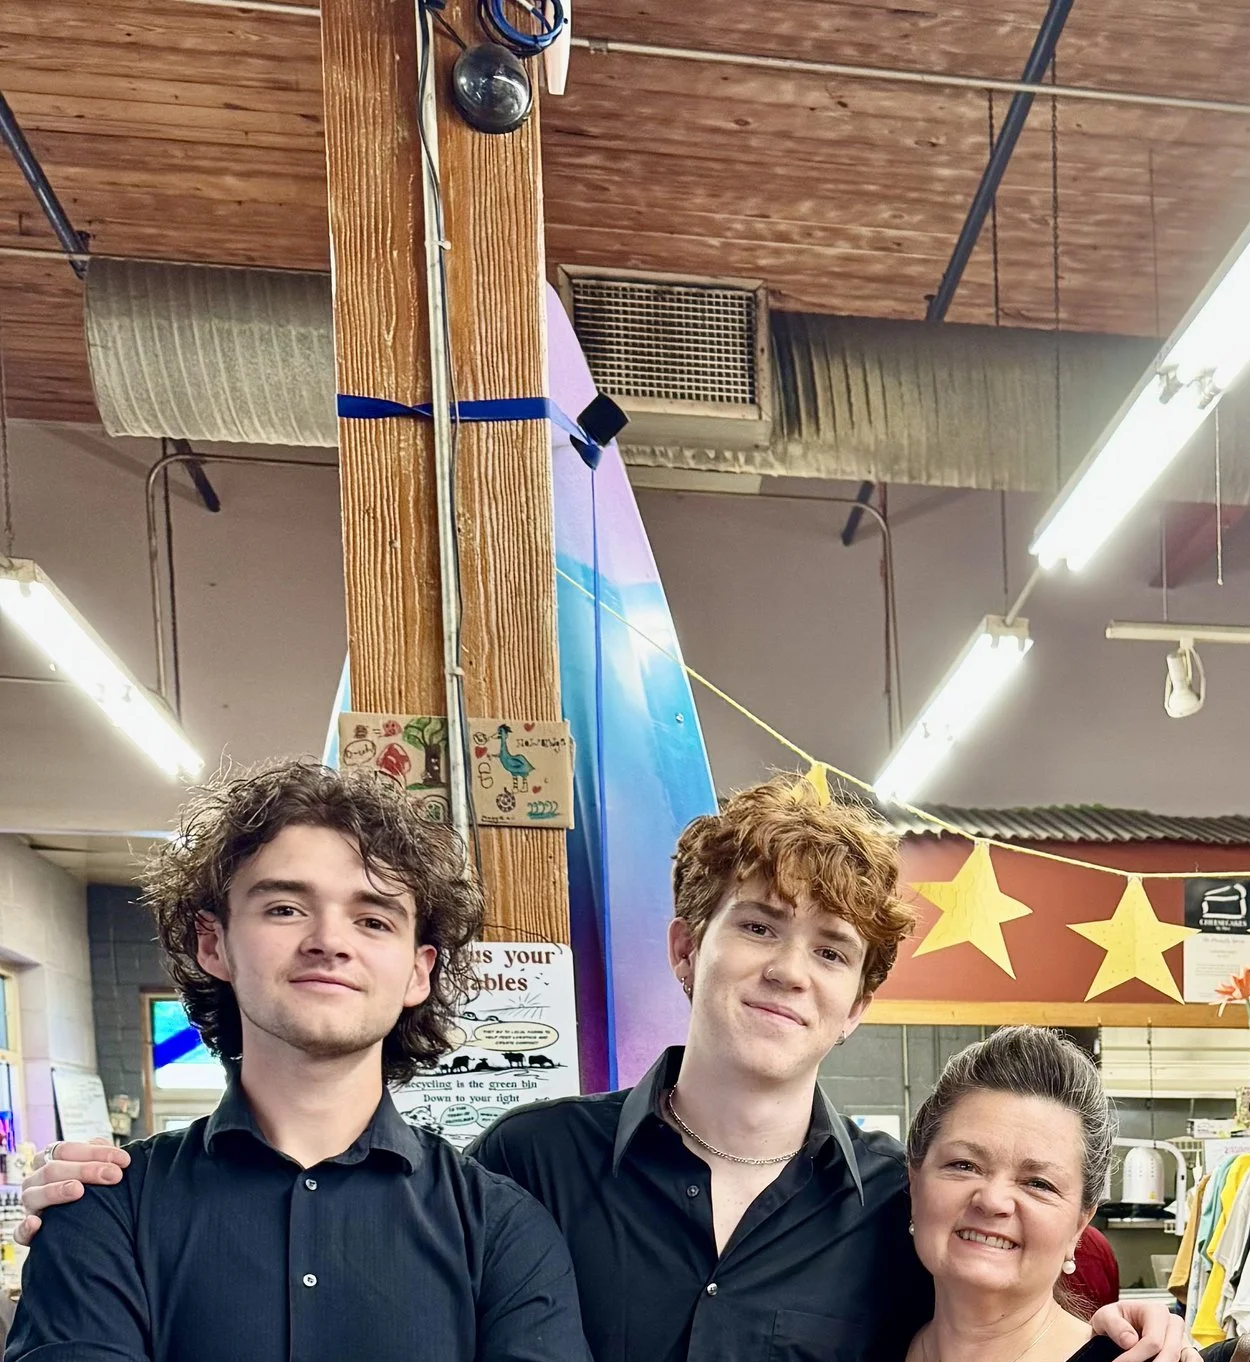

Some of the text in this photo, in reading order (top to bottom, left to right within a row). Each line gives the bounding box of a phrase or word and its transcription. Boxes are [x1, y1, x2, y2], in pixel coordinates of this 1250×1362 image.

[504, 949, 555, 968] your
[456, 1079, 465, 1089] is
[469, 1079, 484, 1089] the
[489, 1080, 517, 1091] green
[522, 1079, 538, 1090] bin
[423, 1093, 520, 1105] Down to your right
